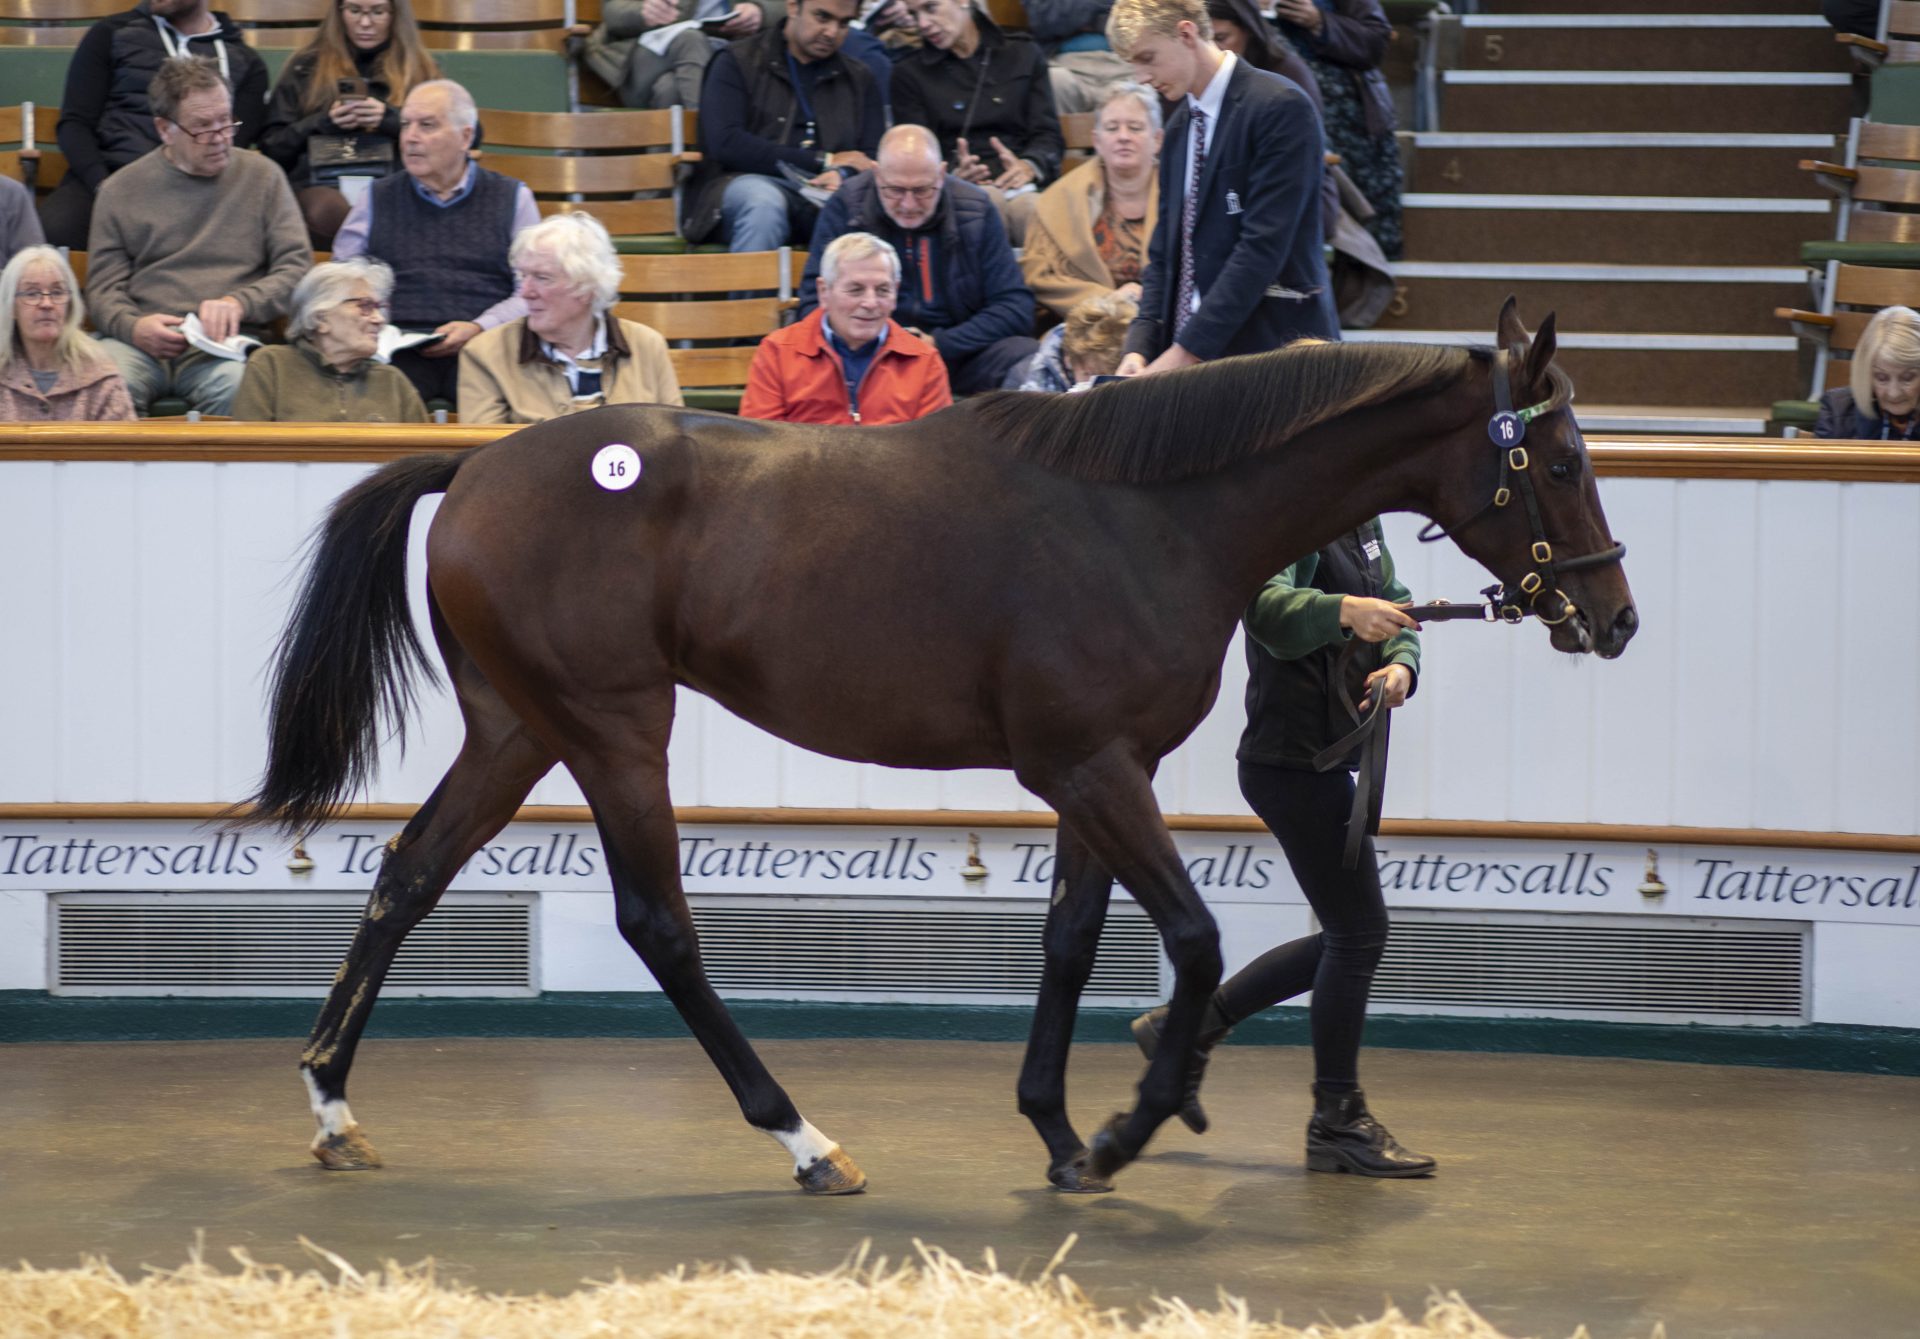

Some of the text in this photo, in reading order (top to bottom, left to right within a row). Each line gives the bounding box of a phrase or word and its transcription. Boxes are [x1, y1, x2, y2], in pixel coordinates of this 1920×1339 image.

[1485, 34, 1504, 62] 5
[1441, 157, 1463, 182] 4
[1500, 420, 1514, 440] 16
[608, 460, 626, 477] 16
[1, 832, 262, 875] Tattersalls
[338, 833, 598, 876] Tasalls
[680, 836, 938, 881] Tattersalls
[1375, 850, 1614, 897] attersalls
